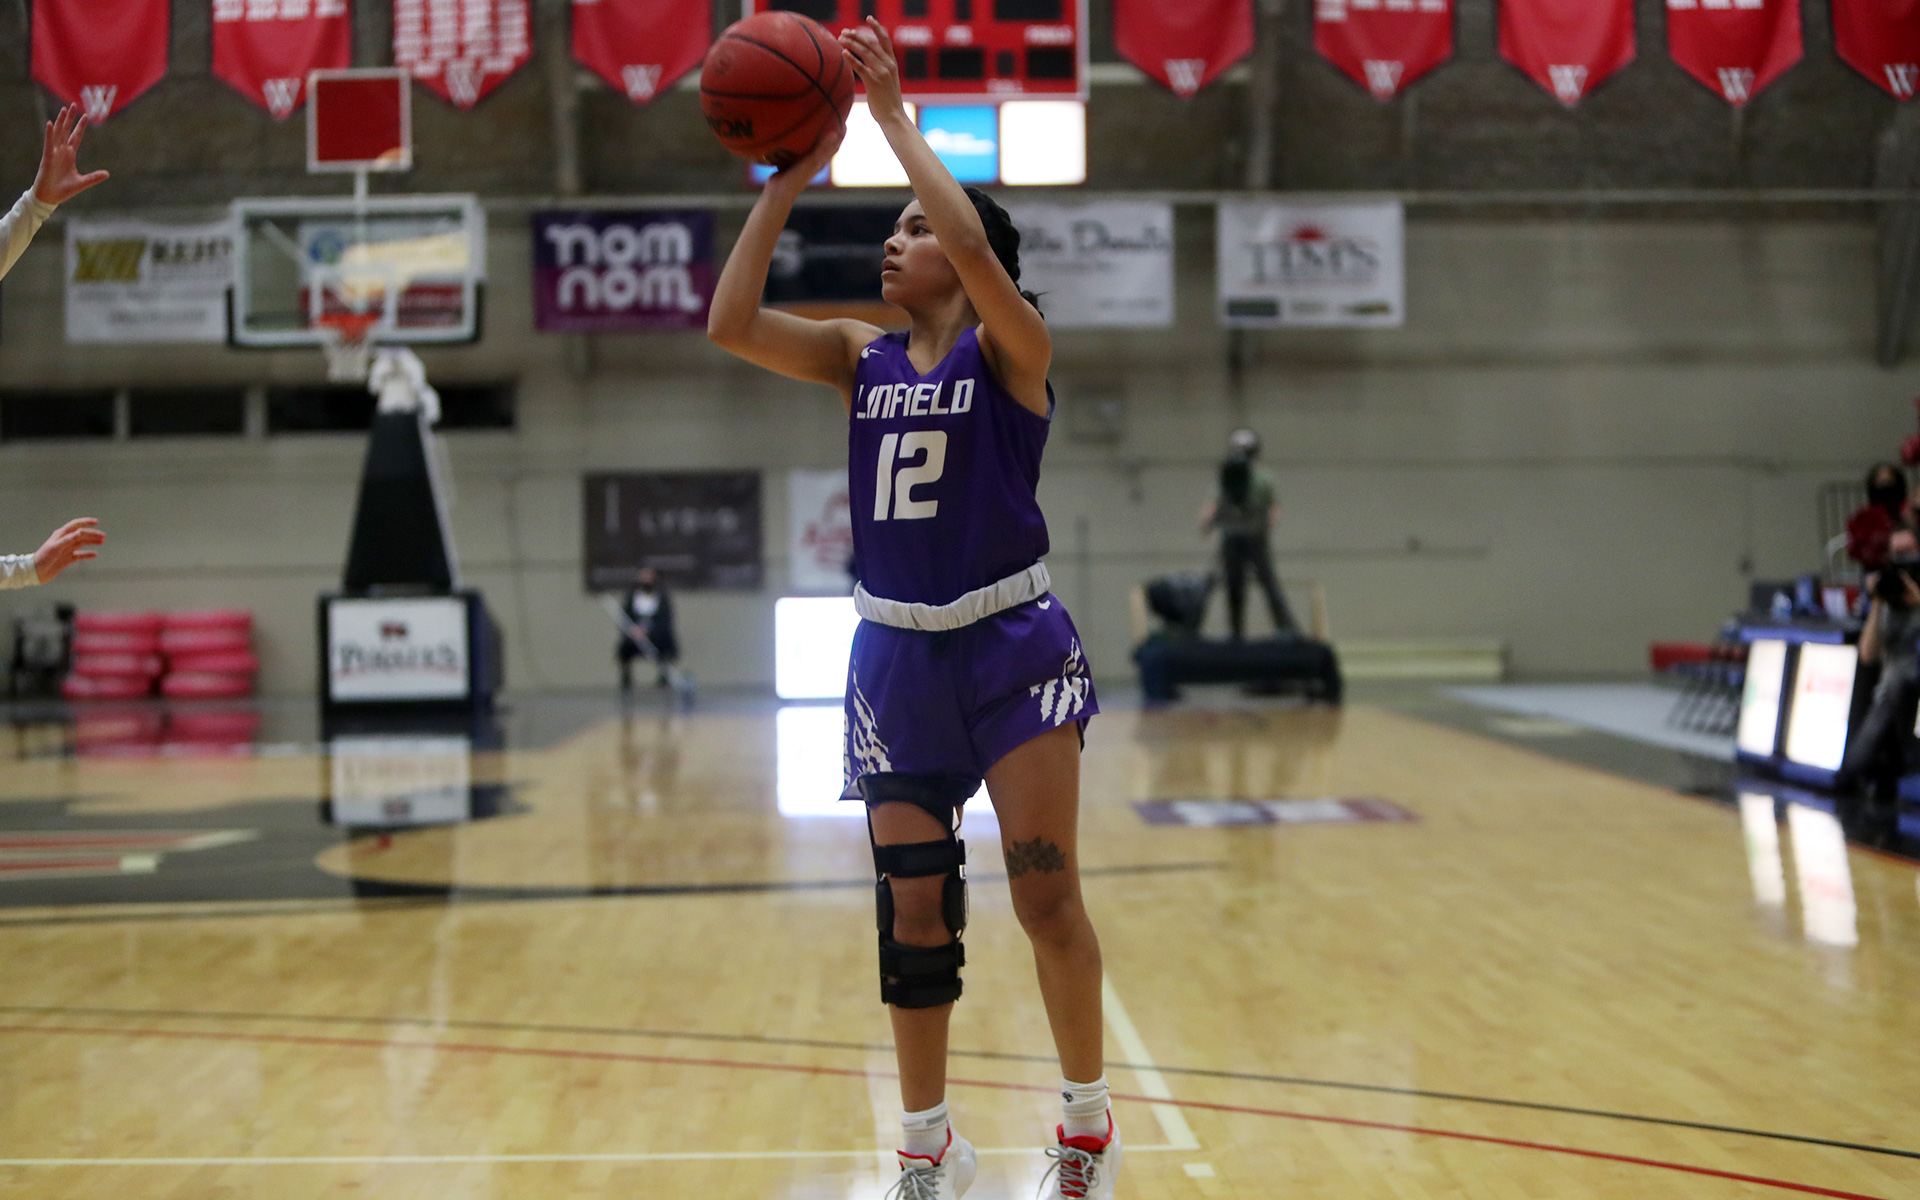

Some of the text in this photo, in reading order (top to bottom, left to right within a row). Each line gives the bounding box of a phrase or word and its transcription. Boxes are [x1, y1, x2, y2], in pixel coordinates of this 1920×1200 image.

[620, 64, 662, 99] W
[1164, 59, 1205, 95] W
[1883, 63, 1919, 96] W
[79, 84, 118, 118] W
[262, 78, 300, 114] W
[545, 223, 692, 267] nom
[557, 267, 703, 312] nom
[857, 378, 975, 419] LINFIELD
[874, 430, 947, 521] 12
